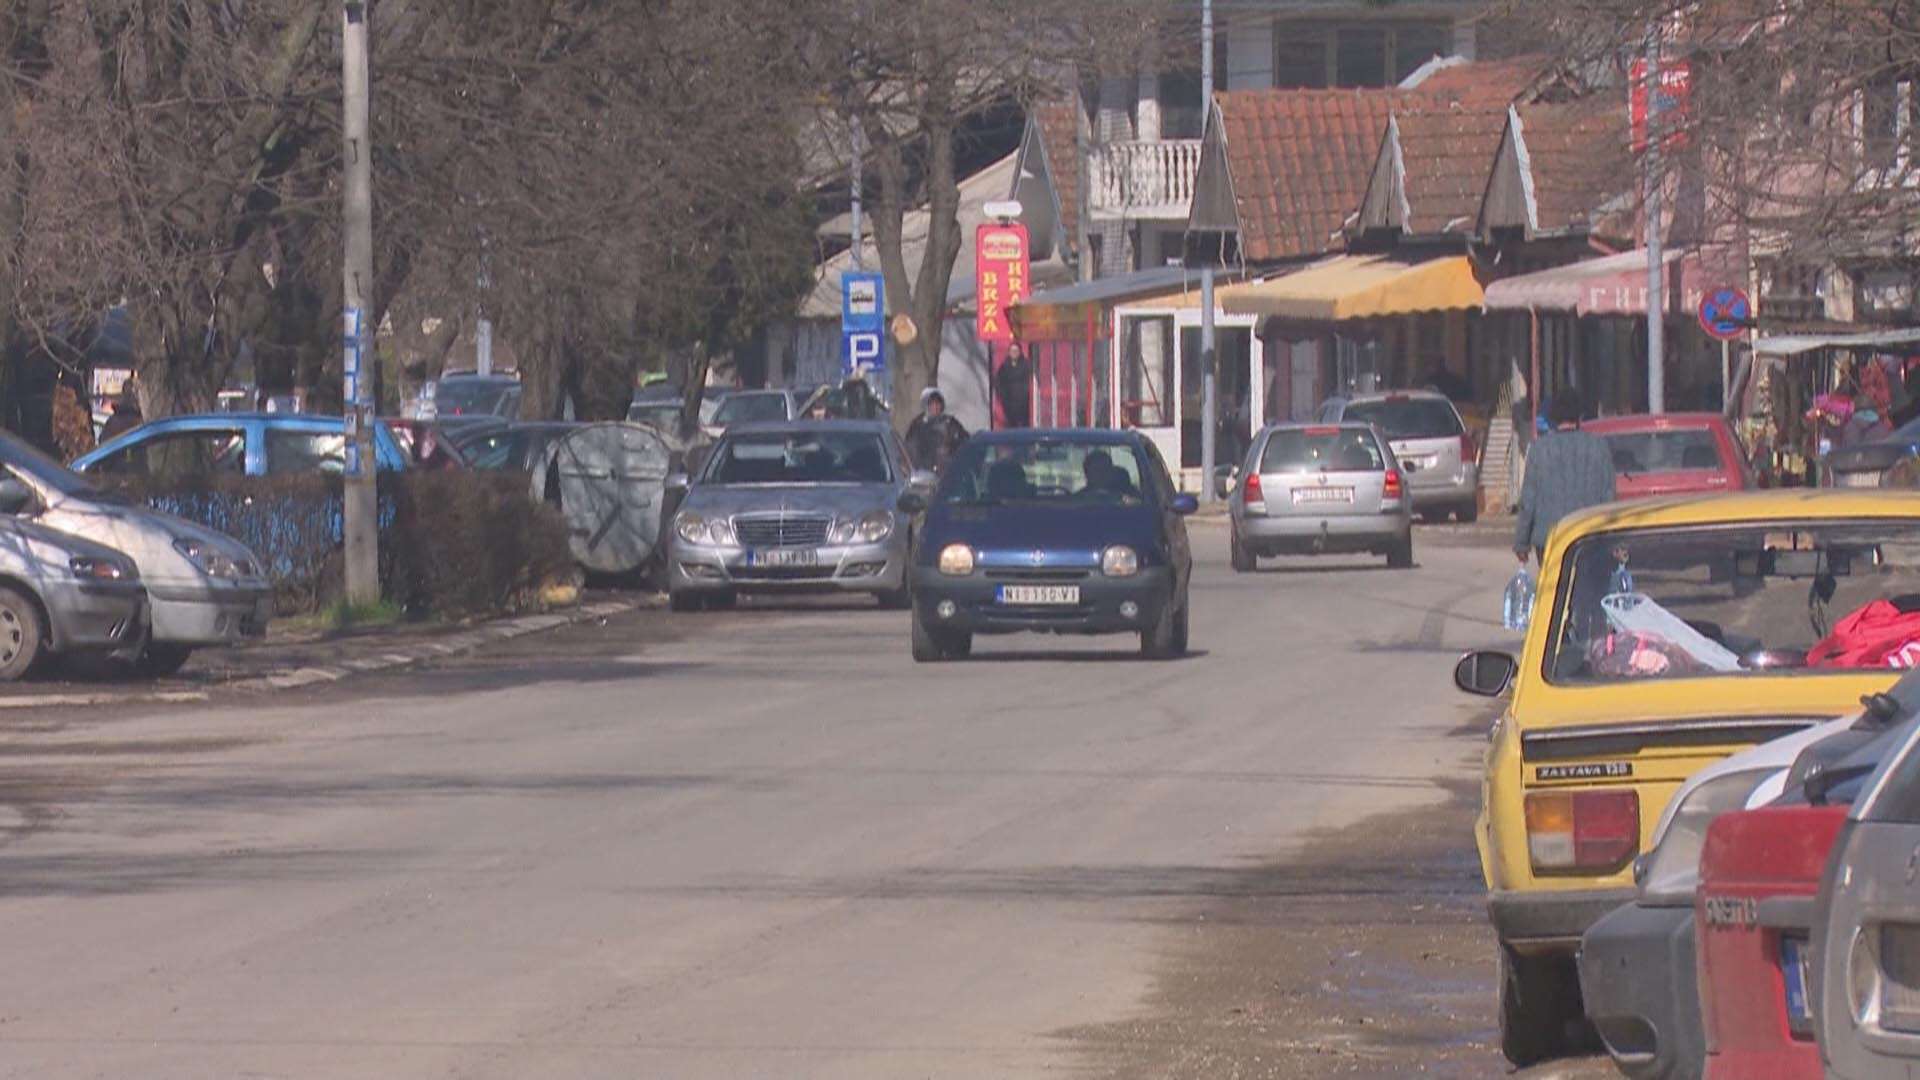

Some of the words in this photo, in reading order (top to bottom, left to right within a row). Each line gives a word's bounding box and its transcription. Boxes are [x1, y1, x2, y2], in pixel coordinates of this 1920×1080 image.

[982, 271, 999, 333] BRZA
[850, 334, 879, 372] P
[1540, 765, 1602, 777] ZASTAVA
